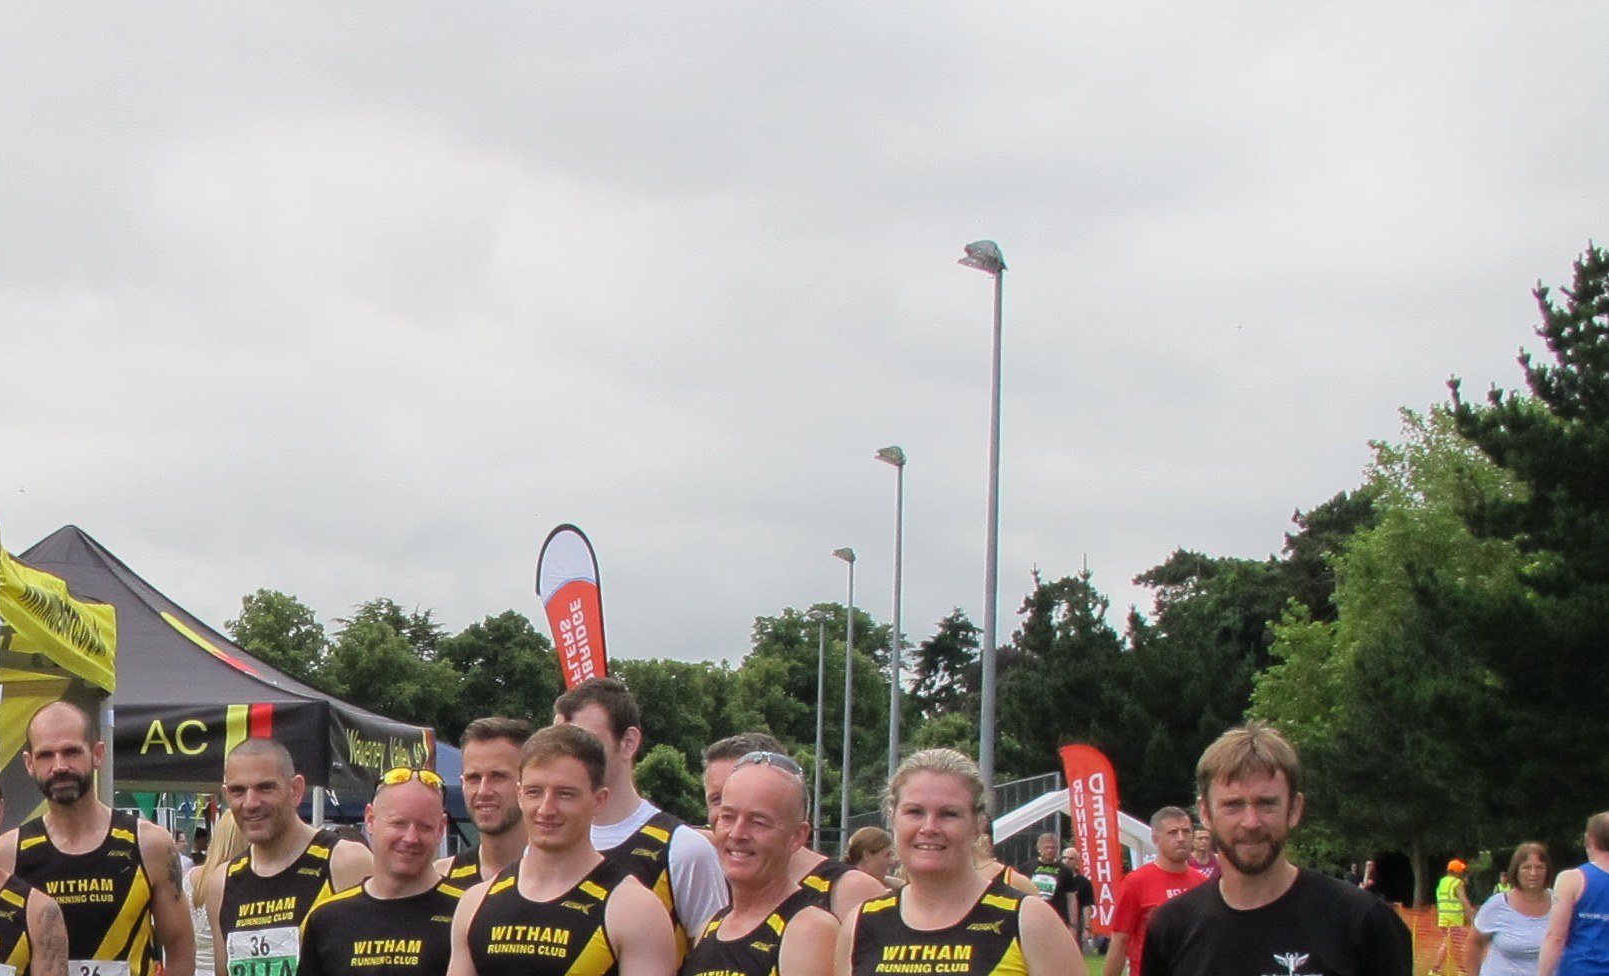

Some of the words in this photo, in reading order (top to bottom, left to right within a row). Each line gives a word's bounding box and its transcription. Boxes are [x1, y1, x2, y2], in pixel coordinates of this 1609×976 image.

[139, 719, 209, 755] AC
[46, 878, 114, 894] WITHAM
[89, 893, 115, 903] CLUB
[238, 896, 297, 917] WITHAM
[235, 914, 273, 928] RUNNING
[273, 911, 295, 923] CLUB
[490, 925, 570, 945] WITHAM
[249, 935, 271, 958] 36
[353, 939, 423, 955] WITHAM
[487, 944, 536, 956] RUNNING
[537, 945, 567, 957] CLUB
[882, 944, 972, 961] WITHAM
[351, 956, 393, 967] RUNNING
[393, 955, 419, 966] CLUB
[875, 961, 933, 974] RUNNING
[934, 962, 970, 974] CLUB
